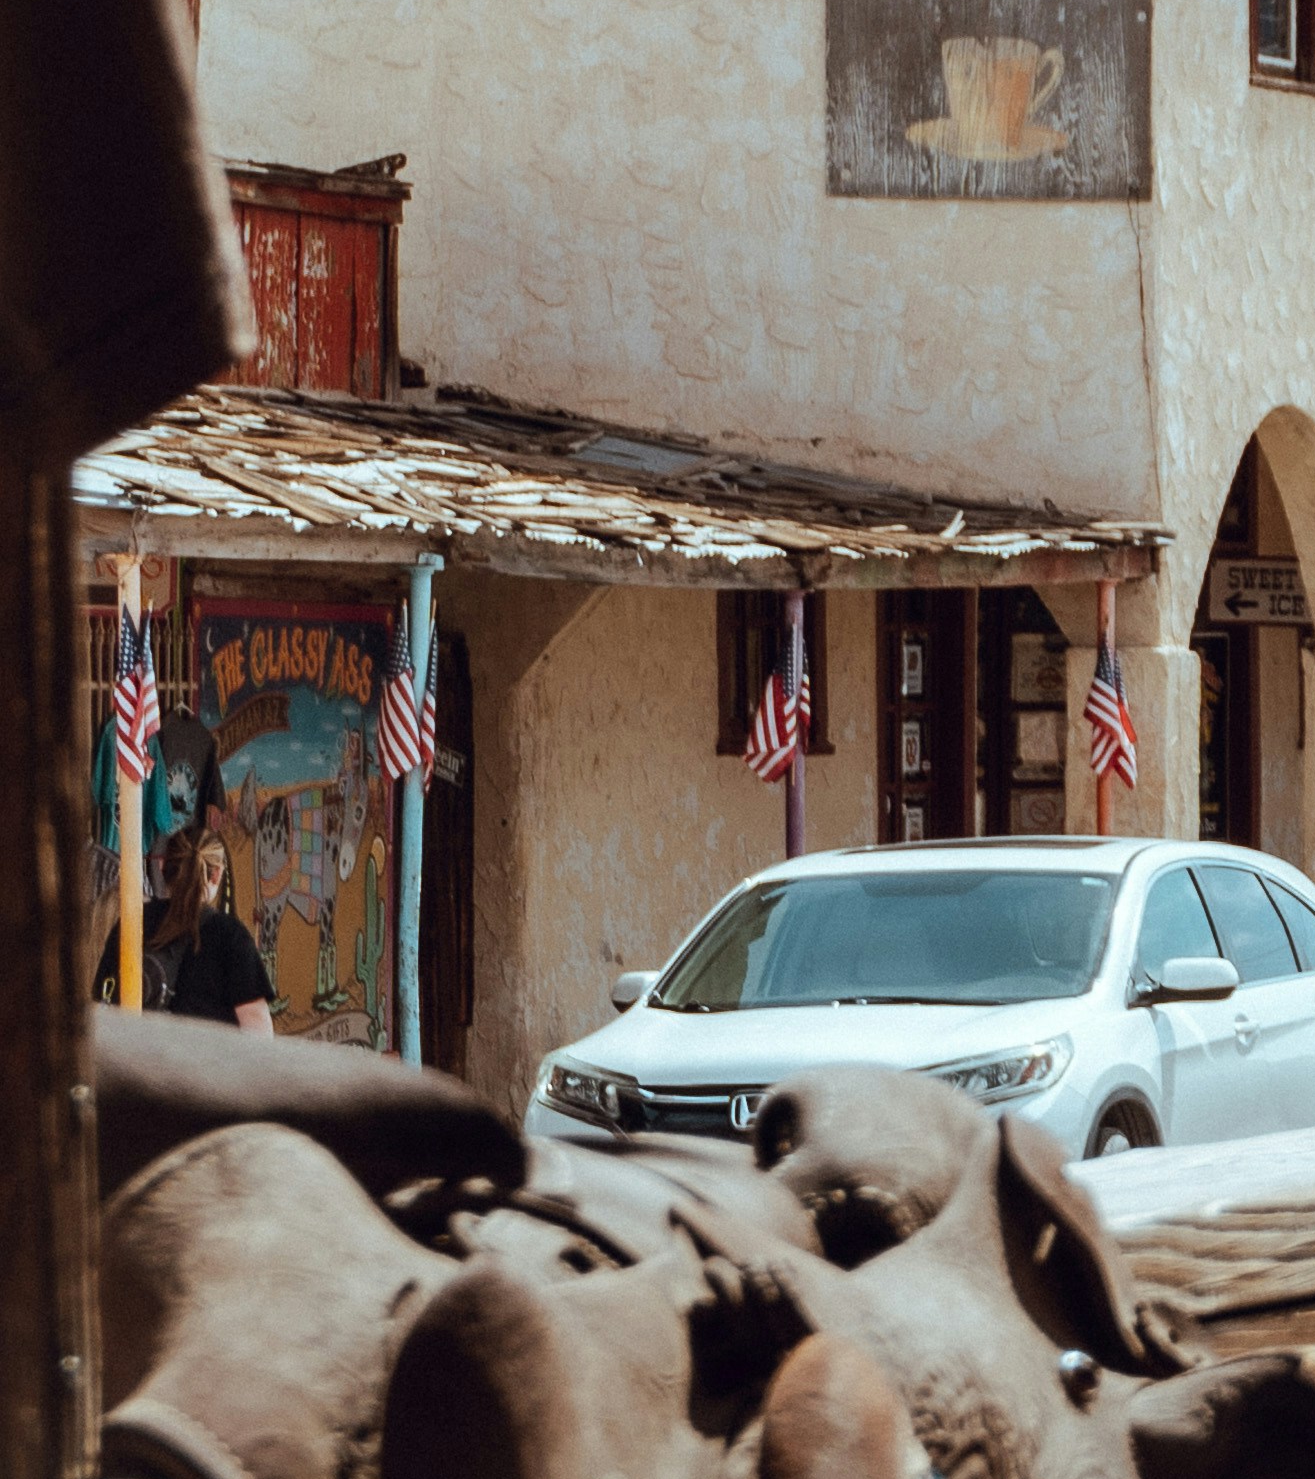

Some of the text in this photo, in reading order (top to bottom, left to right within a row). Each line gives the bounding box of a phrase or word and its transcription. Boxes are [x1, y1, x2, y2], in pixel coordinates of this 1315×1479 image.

[1227, 566, 1298, 591] SWEET
[211, 626, 373, 720] THE CLASSY ASS
